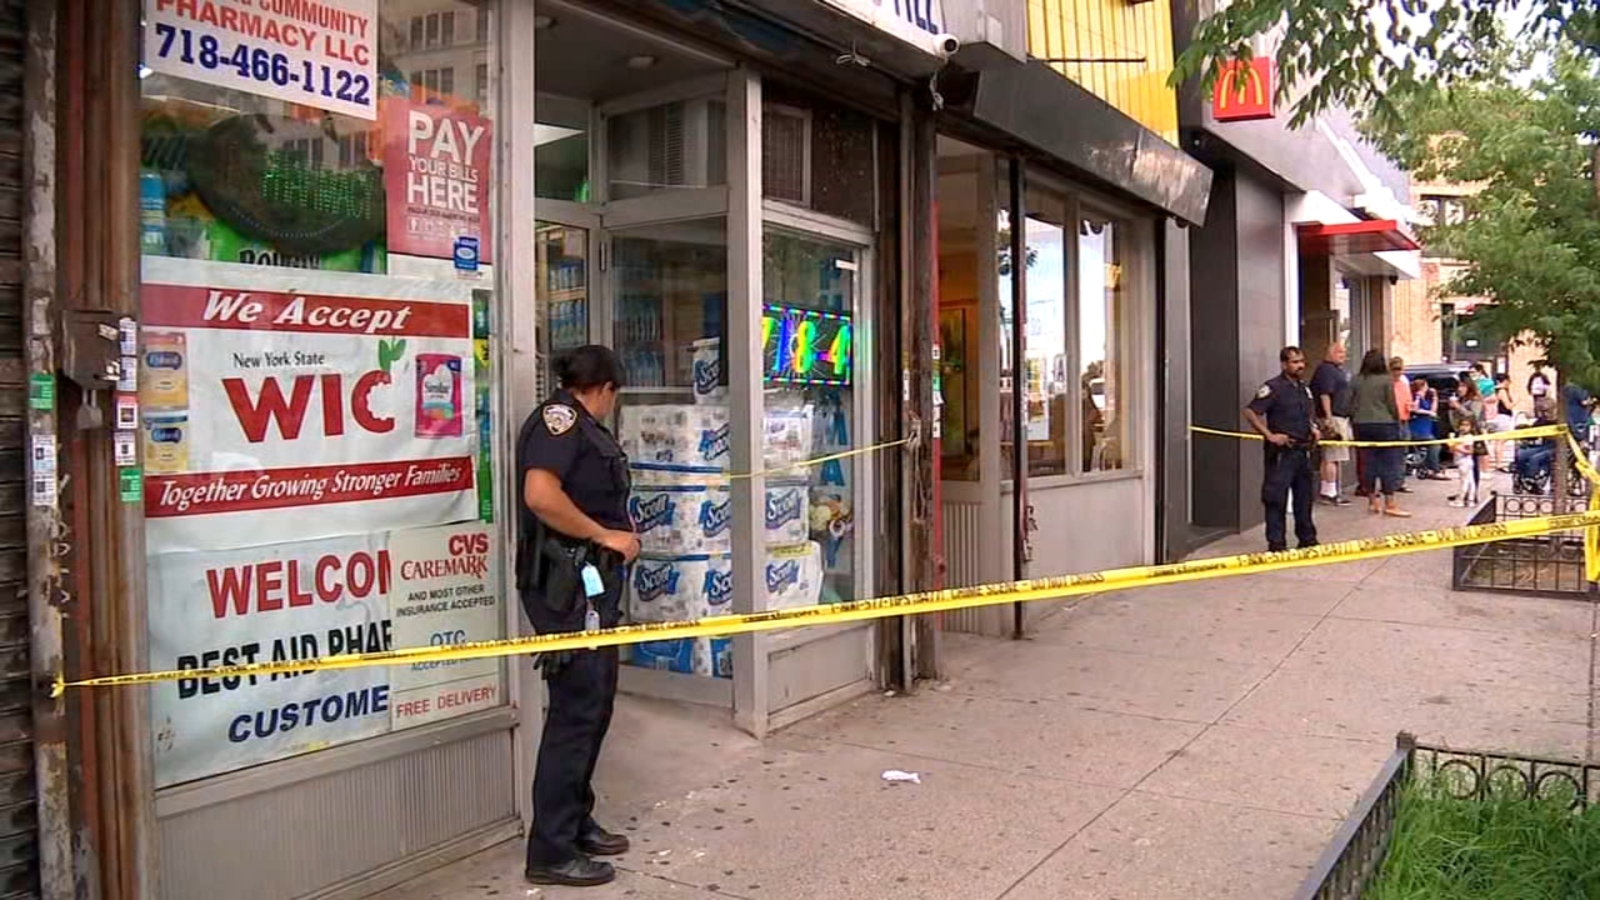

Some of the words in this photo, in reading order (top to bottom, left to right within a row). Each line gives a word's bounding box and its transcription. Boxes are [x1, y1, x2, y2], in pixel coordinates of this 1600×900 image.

[156, 0, 317, 51] PHARMACY
[325, 35, 370, 66] LLC
[155, 22, 370, 106] 718-466-1122
[408, 109, 485, 166] PAY
[409, 155, 446, 176] YOUR
[448, 162, 479, 183] BILLS
[407, 172, 480, 214] HERE
[203, 290, 263, 323] We
[273, 297, 412, 333] Accept
[233, 352, 262, 369] New
[265, 350, 291, 367] York
[294, 350, 325, 366] State
[221, 369, 395, 442] WIC
[160, 479, 244, 510] Together
[251, 474, 326, 499] Growing
[331, 469, 401, 495] Stronger
[404, 464, 461, 485] Families
[449, 532, 488, 556] CVS
[400, 555, 488, 580] CAREMARK
[396, 601, 448, 618] INSURANCE
[450, 595, 495, 611] ACCEPTED
[408, 590, 427, 602] AND
[429, 587, 453, 600] MOST
[455, 584, 485, 597] OTHER
[177, 643, 260, 700] BEST
[270, 633, 318, 682] AID
[228, 685, 389, 742] CUSTOME
[396, 698, 430, 718] FREE
[437, 684, 496, 709] DELIVERY
